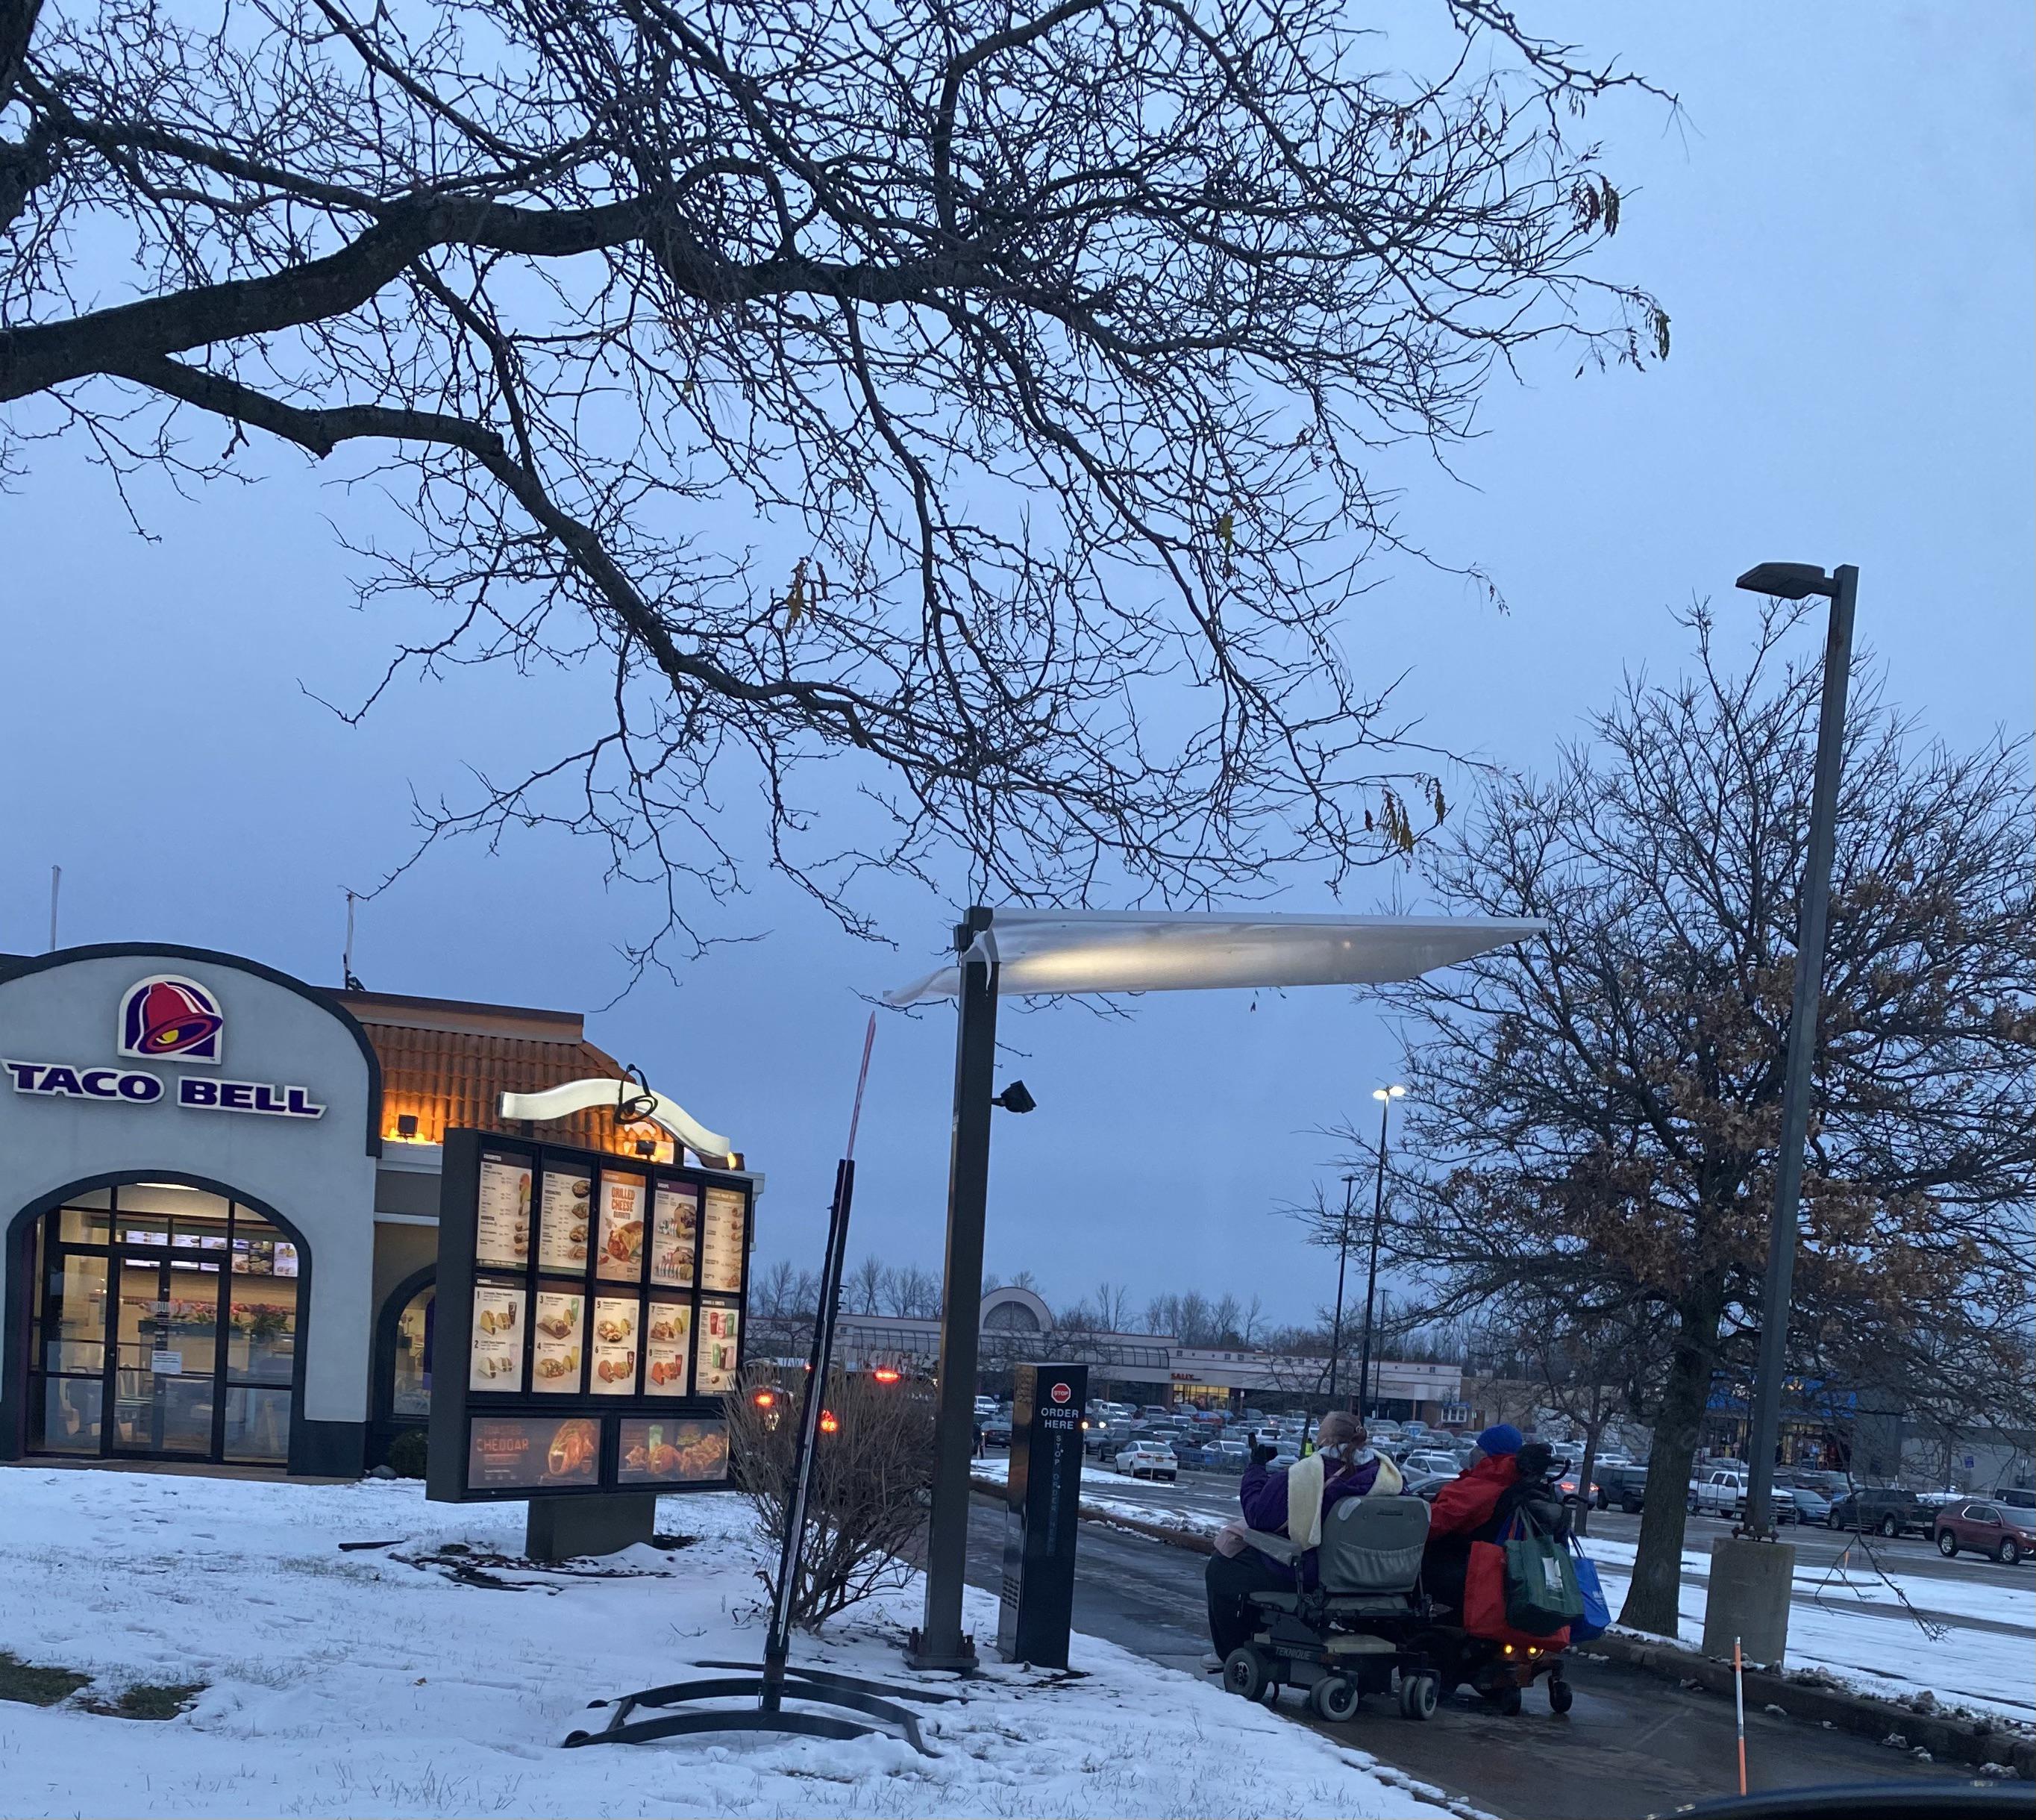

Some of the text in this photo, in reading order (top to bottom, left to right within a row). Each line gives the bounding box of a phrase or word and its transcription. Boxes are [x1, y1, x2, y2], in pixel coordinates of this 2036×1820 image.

[7, 1063, 325, 1116] TACO BELL
[611, 1198, 633, 1213] CHEESE
[477, 1291, 480, 1299] 1
[540, 1295, 544, 1304] 3
[597, 1301, 601, 1309] 5
[651, 1305, 655, 1313] 7
[474, 1340, 478, 1349] 2
[537, 1342, 541, 1350] 4
[1041, 1407, 1079, 1419] ORDER
[1044, 1419, 1074, 1430] HERE
[476, 1438, 530, 1451] CHEDDAR
[1054, 1435, 1062, 1466] STOP
